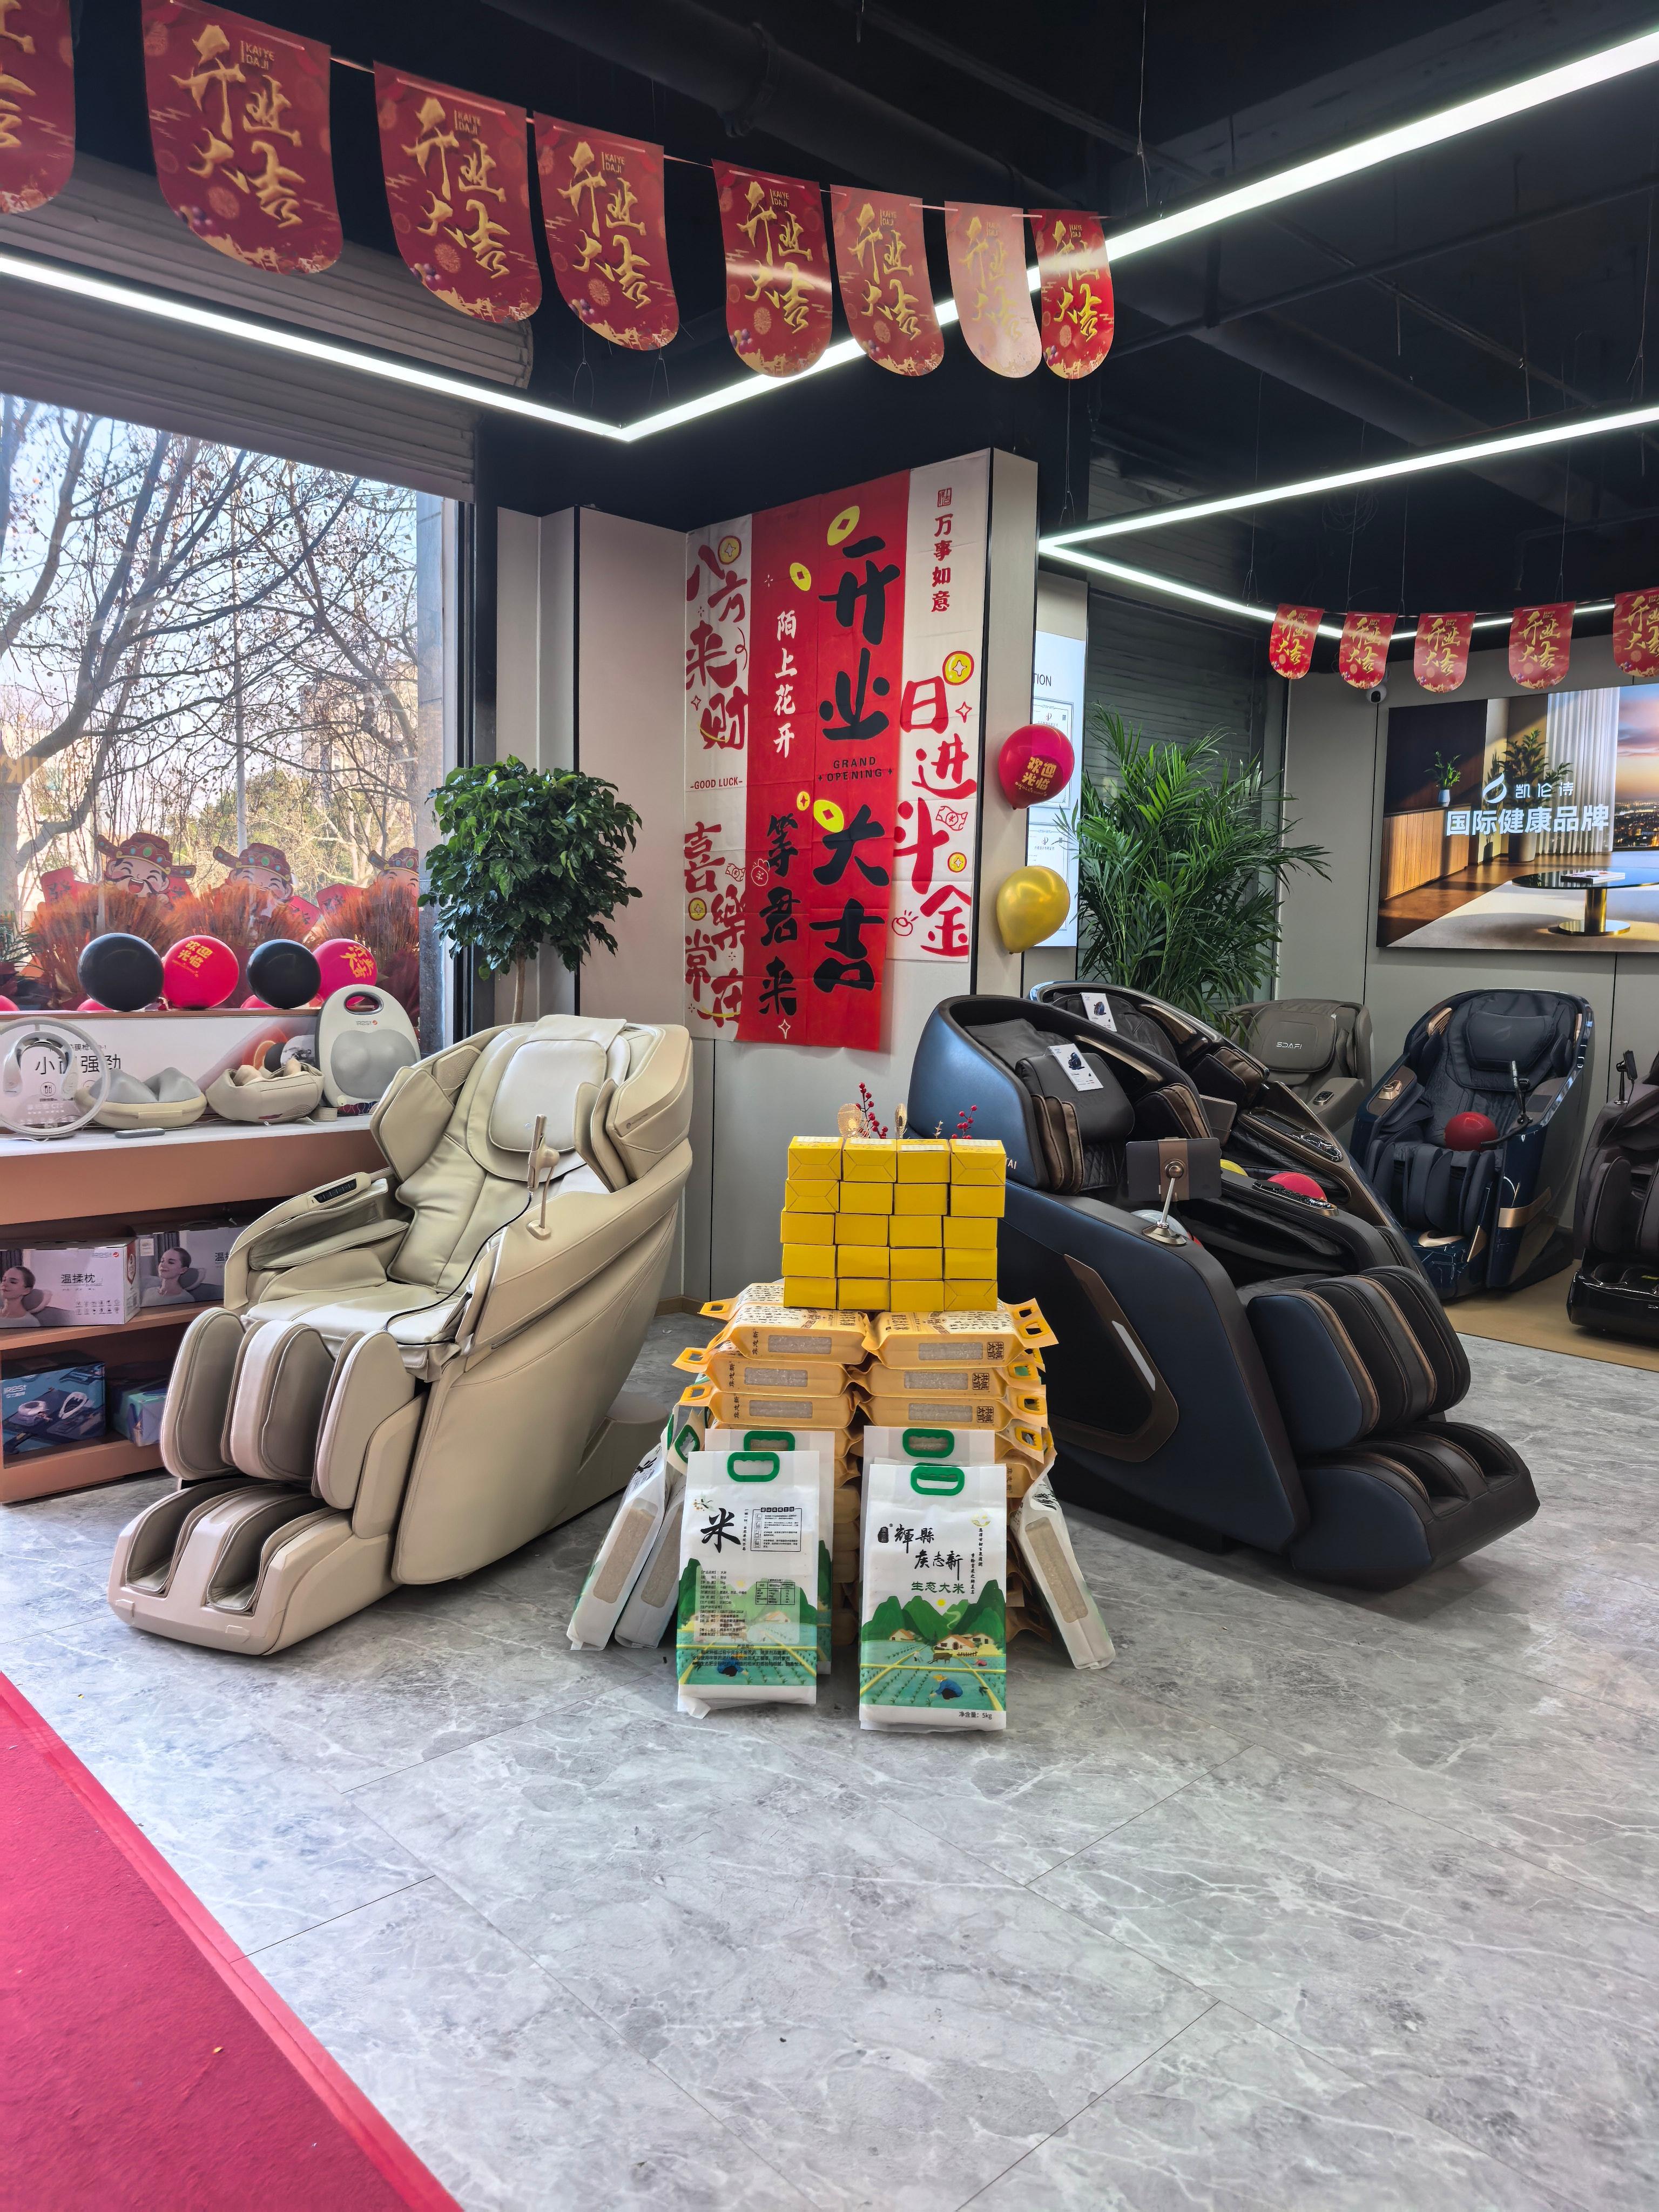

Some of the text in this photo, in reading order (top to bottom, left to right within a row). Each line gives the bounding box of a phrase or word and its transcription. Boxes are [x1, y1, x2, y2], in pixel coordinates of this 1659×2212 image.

[931, 514, 953, 612] 万事如意
[773, 610, 797, 758] 陌上花开
[833, 756, 876, 770] GRAND
[1027, 757, 1057, 778] 欢迎
[827, 768, 883, 782] OPENING
[1021, 772, 1050, 790] 光临
[1515, 781, 1574, 799] 凯伦诗
[894, 676, 977, 957] 日进斗金
[1446, 802, 1609, 837] 国际健康品牌
[758, 813, 801, 1016] 等君来
[61, 1273, 96, 1284] 温揉枕
[700, 1507, 741, 1553] 米
[911, 1581, 965, 1594] 生态大米
